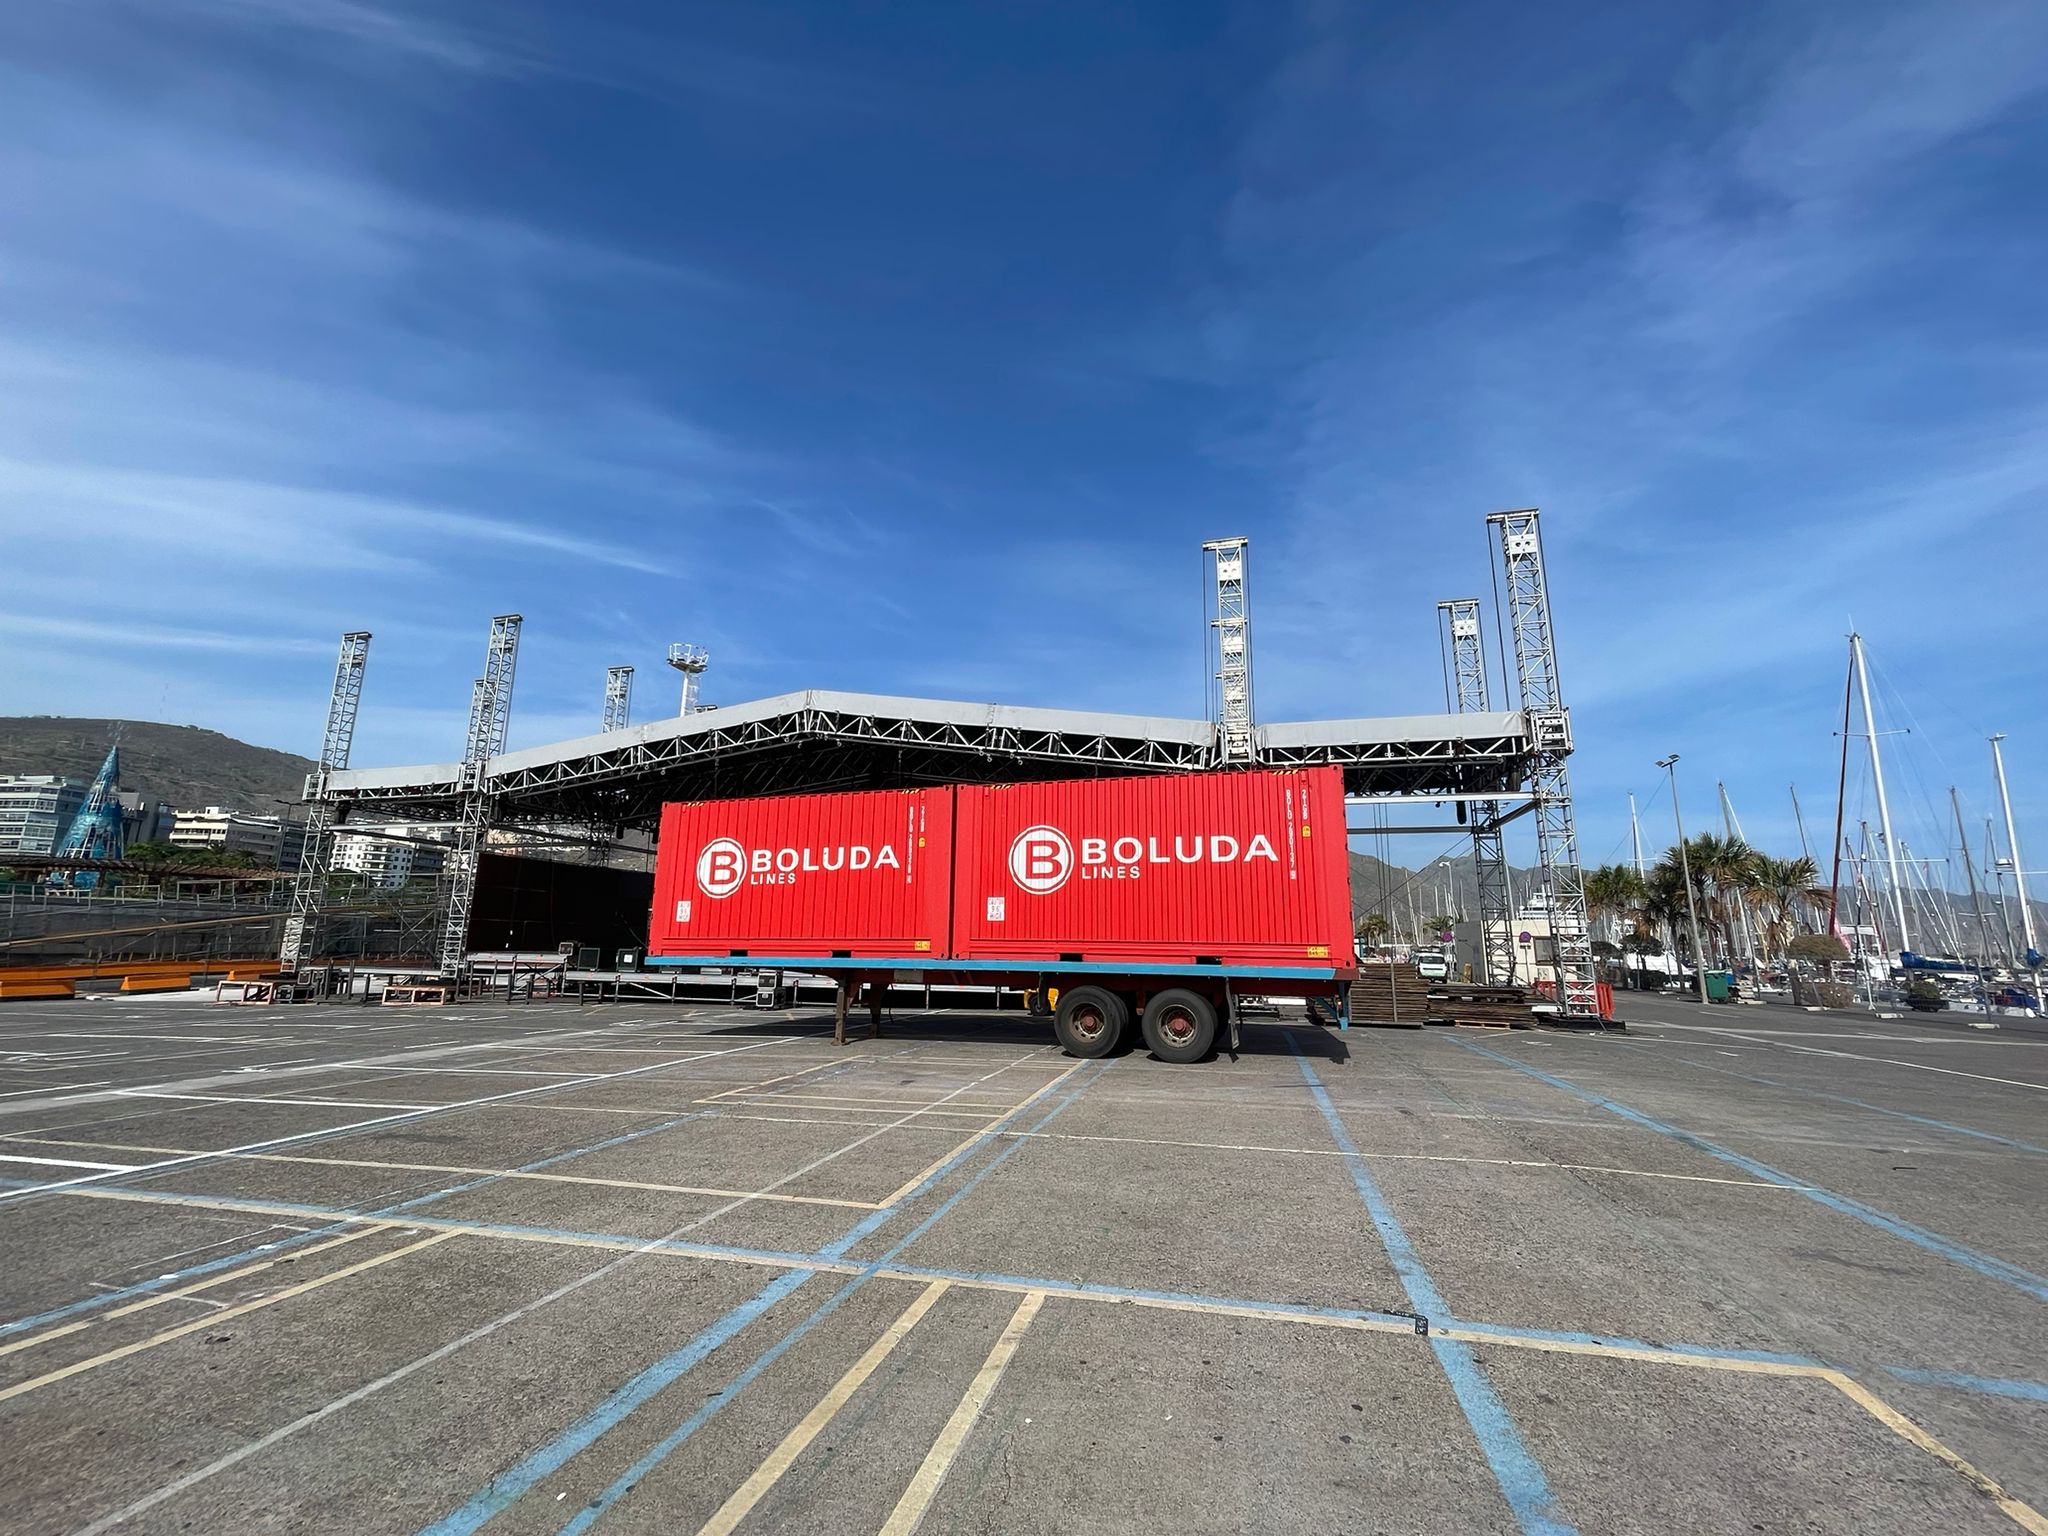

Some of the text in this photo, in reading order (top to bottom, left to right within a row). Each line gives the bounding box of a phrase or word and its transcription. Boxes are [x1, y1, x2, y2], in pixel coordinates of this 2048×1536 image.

[751, 845, 901, 872] BOLUDA
[1081, 834, 1279, 864] BOLUDA
[751, 873, 797, 885] LINES
[1082, 866, 1140, 880] LINES
